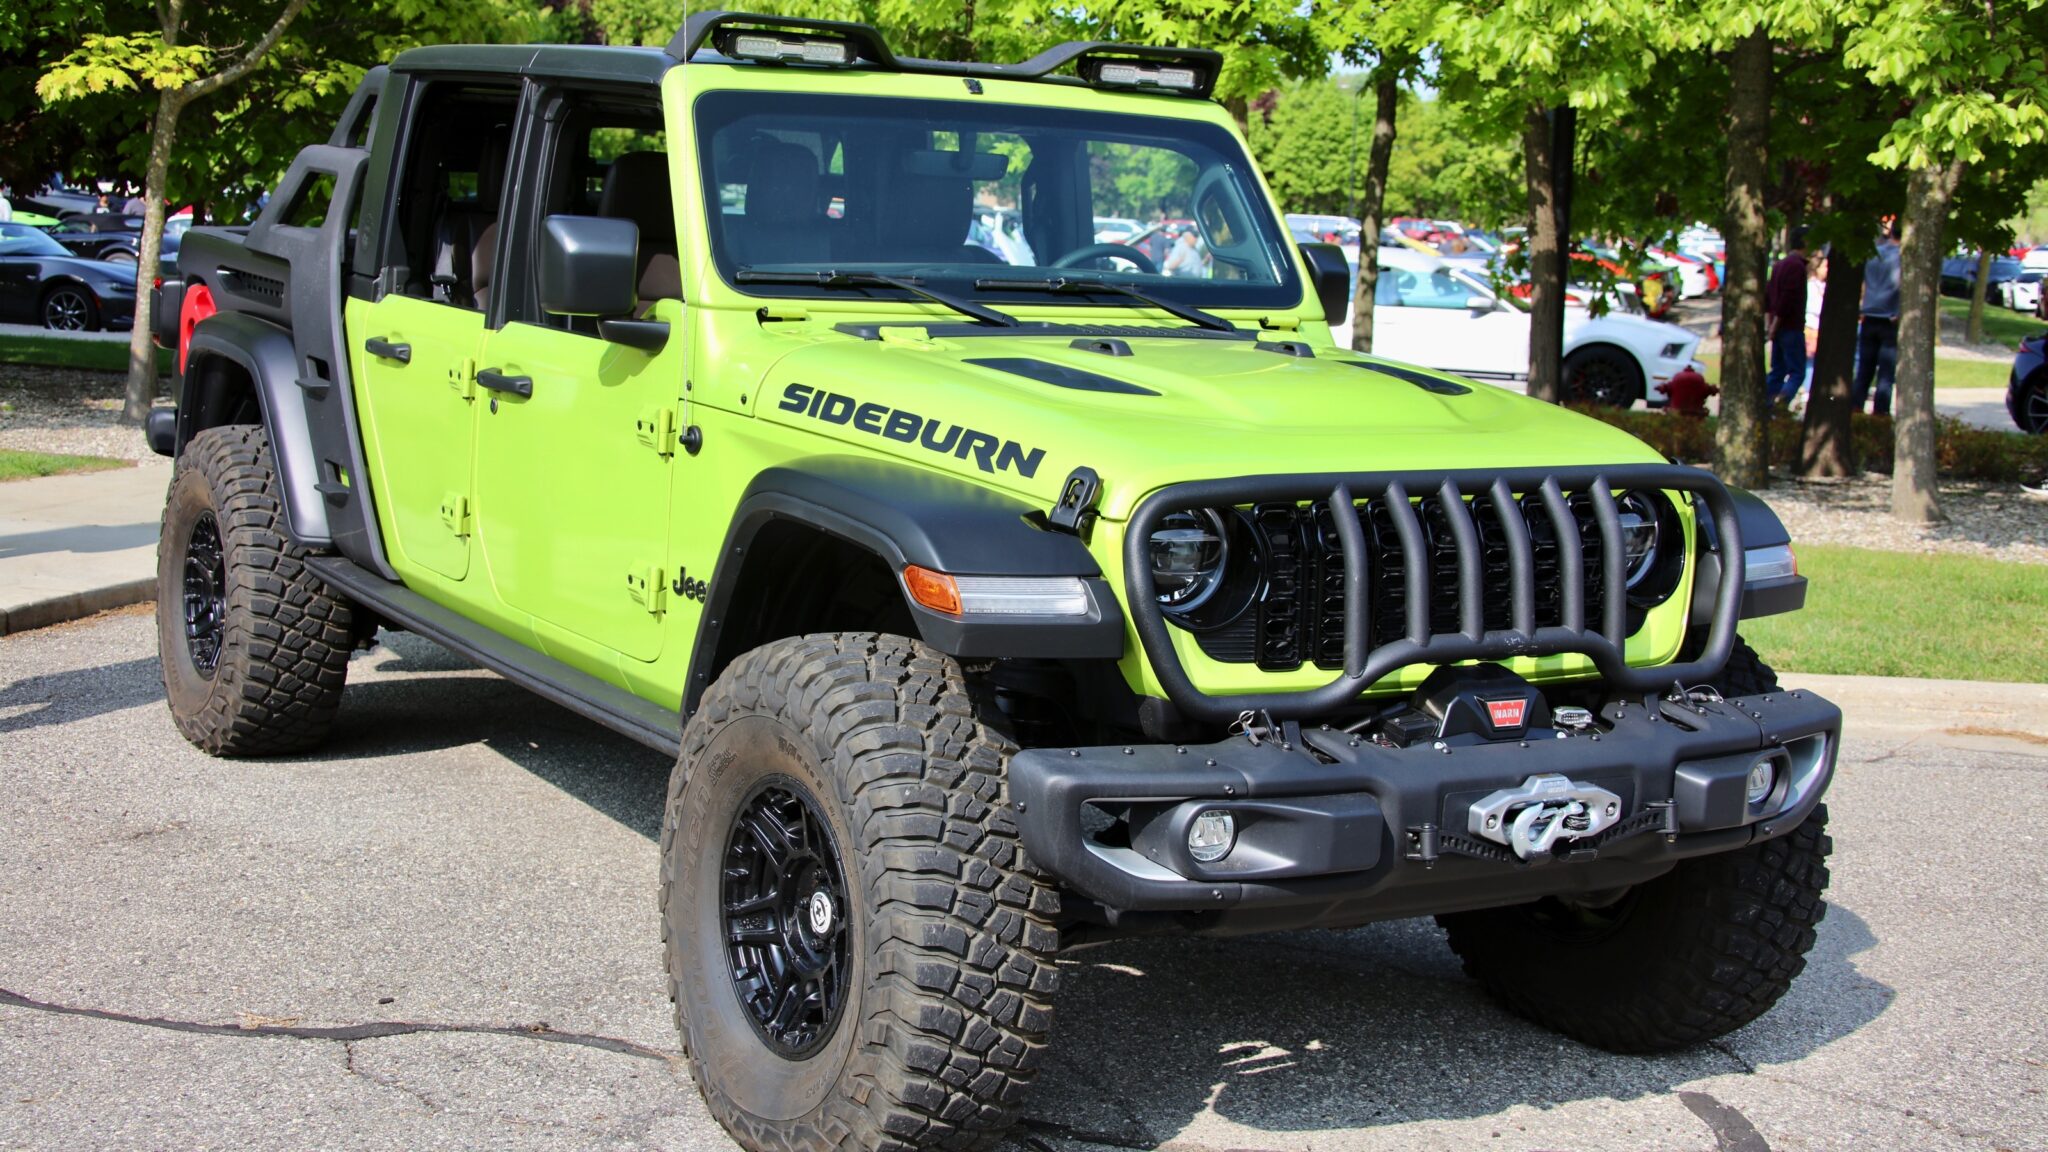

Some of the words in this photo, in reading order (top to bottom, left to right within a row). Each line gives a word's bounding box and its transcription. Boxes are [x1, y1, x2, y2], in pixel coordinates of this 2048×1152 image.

[778, 383, 1047, 479] SIDEBURN
[672, 566, 710, 604] Jee
[1494, 708, 1520, 719] WARN
